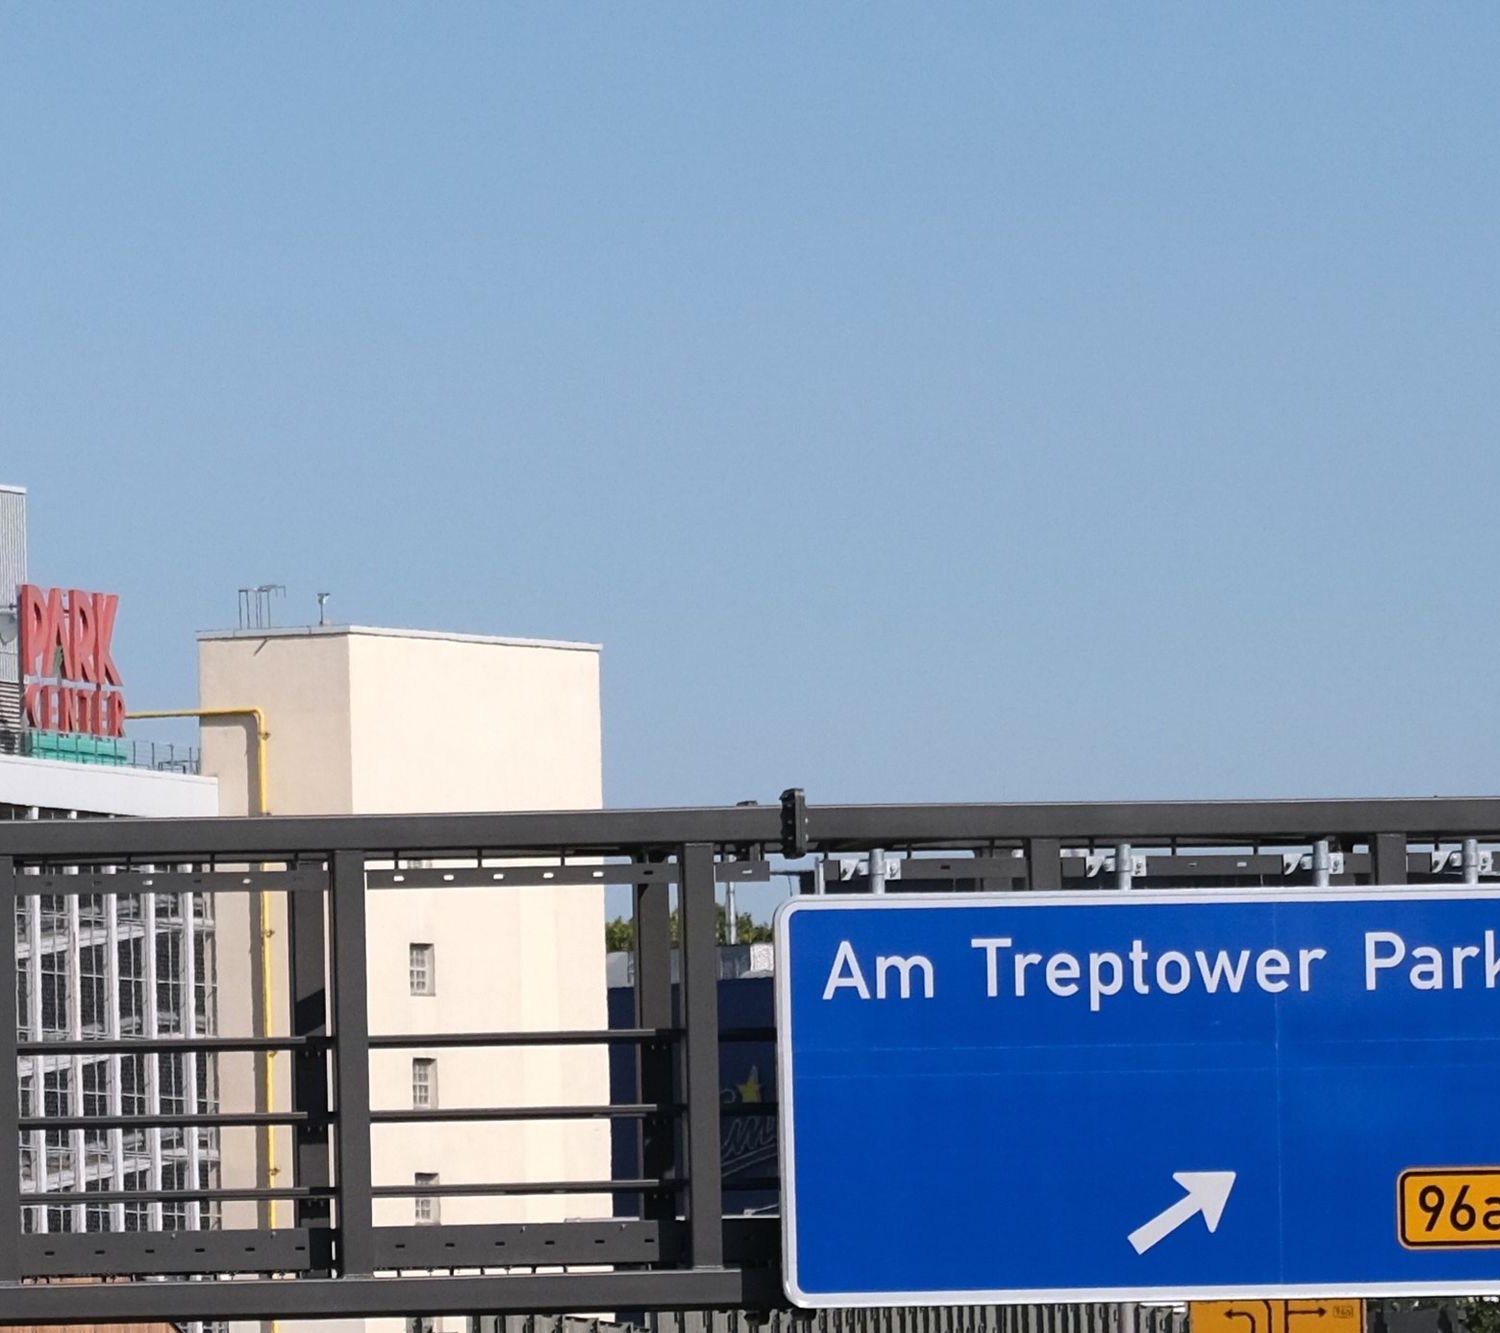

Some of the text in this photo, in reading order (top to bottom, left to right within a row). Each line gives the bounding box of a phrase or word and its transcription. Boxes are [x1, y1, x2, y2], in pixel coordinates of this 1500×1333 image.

[17, 583, 124, 687] PARK
[22, 684, 126, 738] CENTER
[822, 940, 935, 1001] Am
[970, 937, 1327, 1011] Treptower
